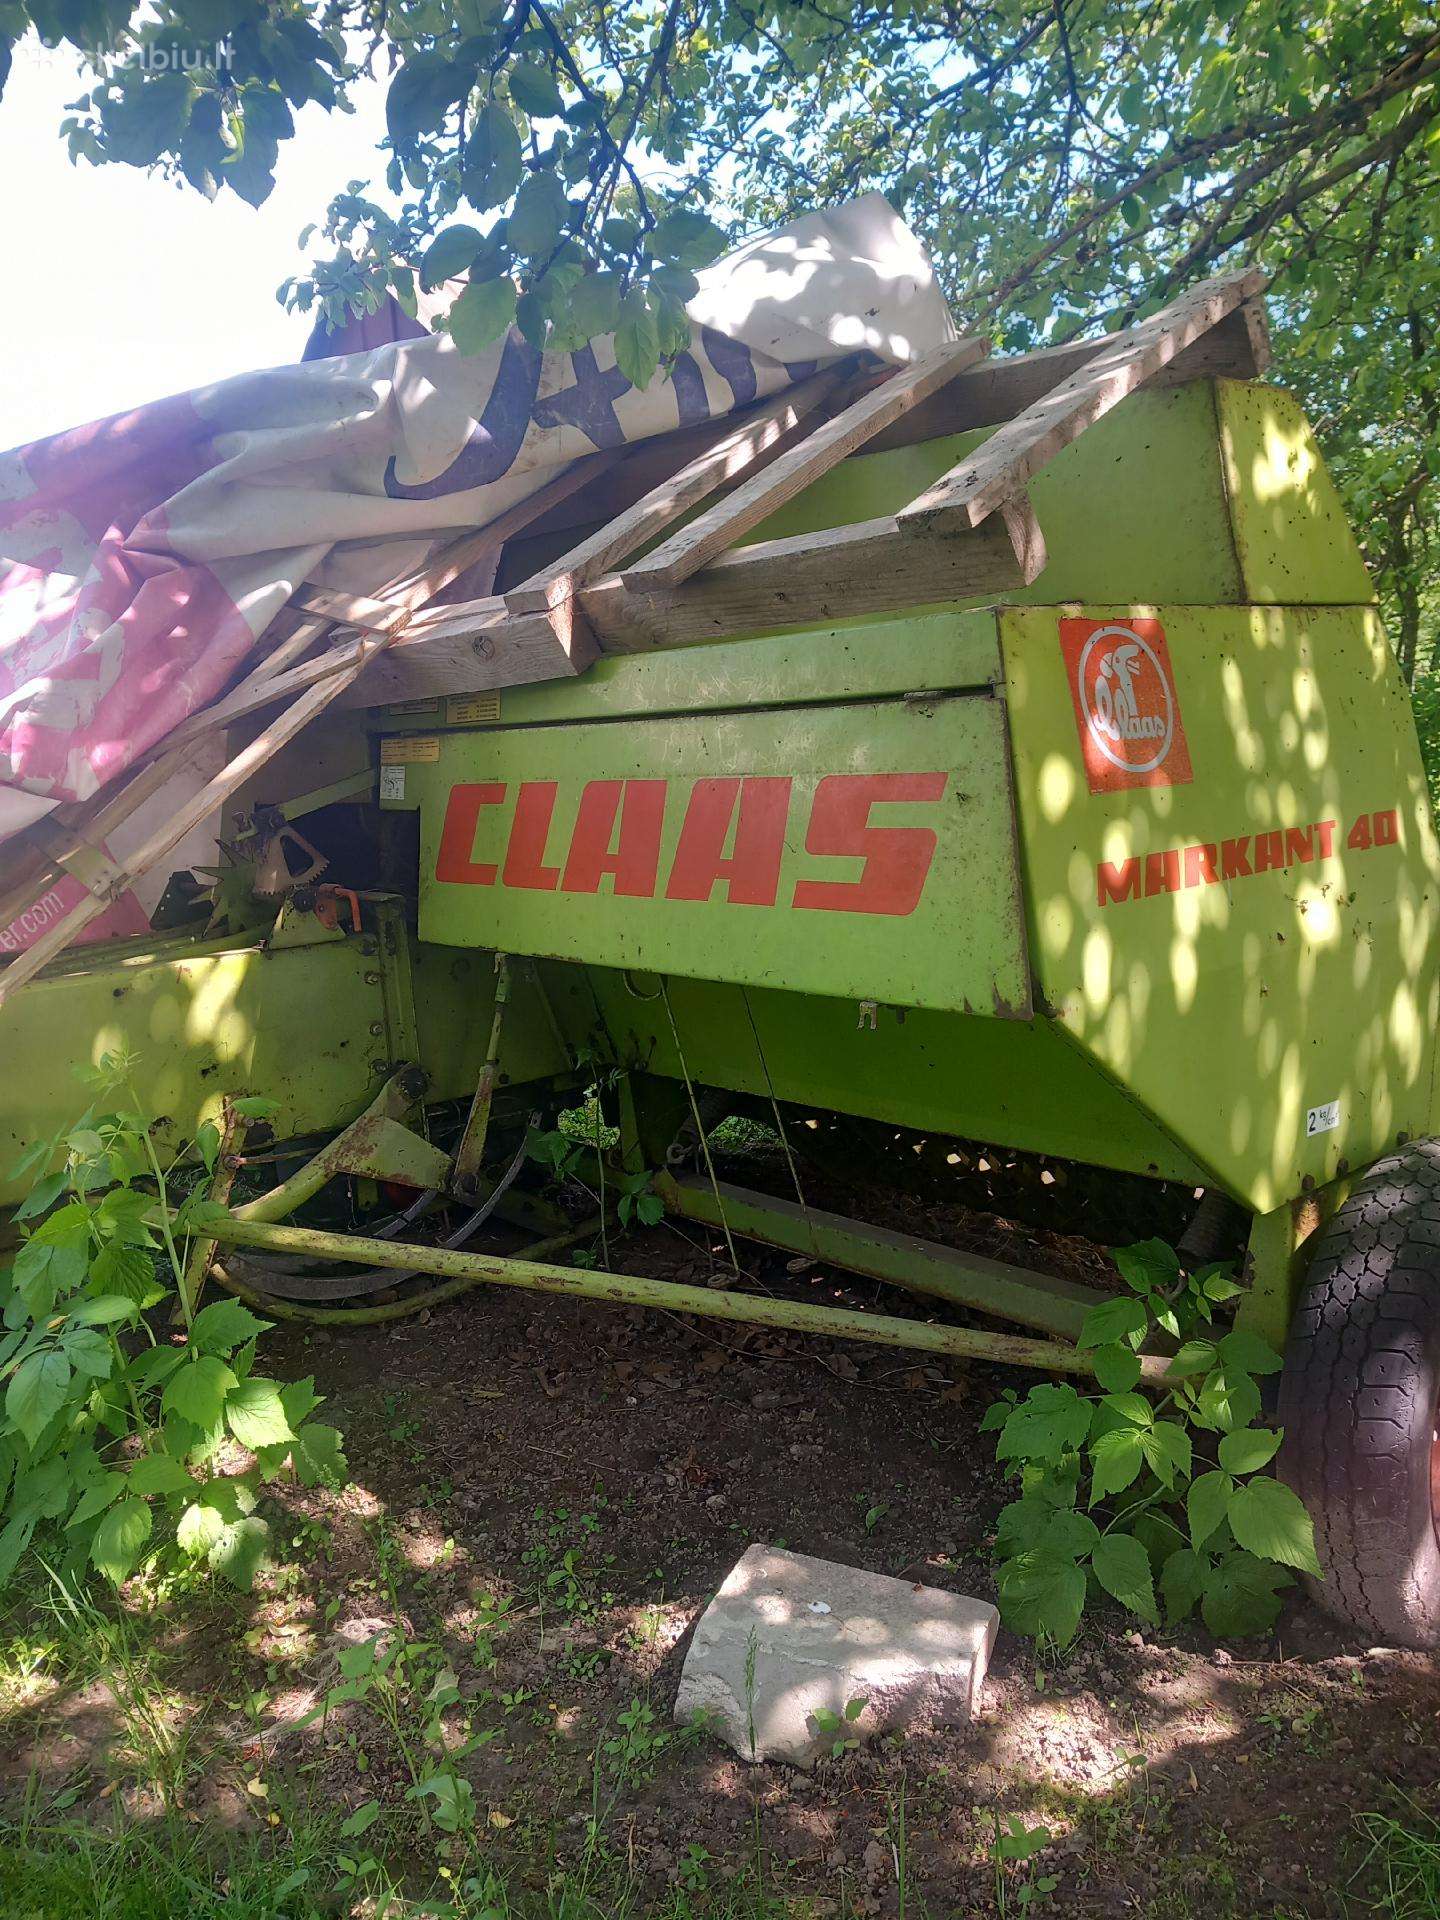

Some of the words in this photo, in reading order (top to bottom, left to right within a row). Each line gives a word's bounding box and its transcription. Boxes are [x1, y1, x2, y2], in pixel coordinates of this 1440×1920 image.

[435, 772, 948, 916] CLAAS
[1096, 819, 1337, 907] MARKANT
[1347, 808, 1398, 851] 40
[1308, 1111, 1316, 1133] 2
